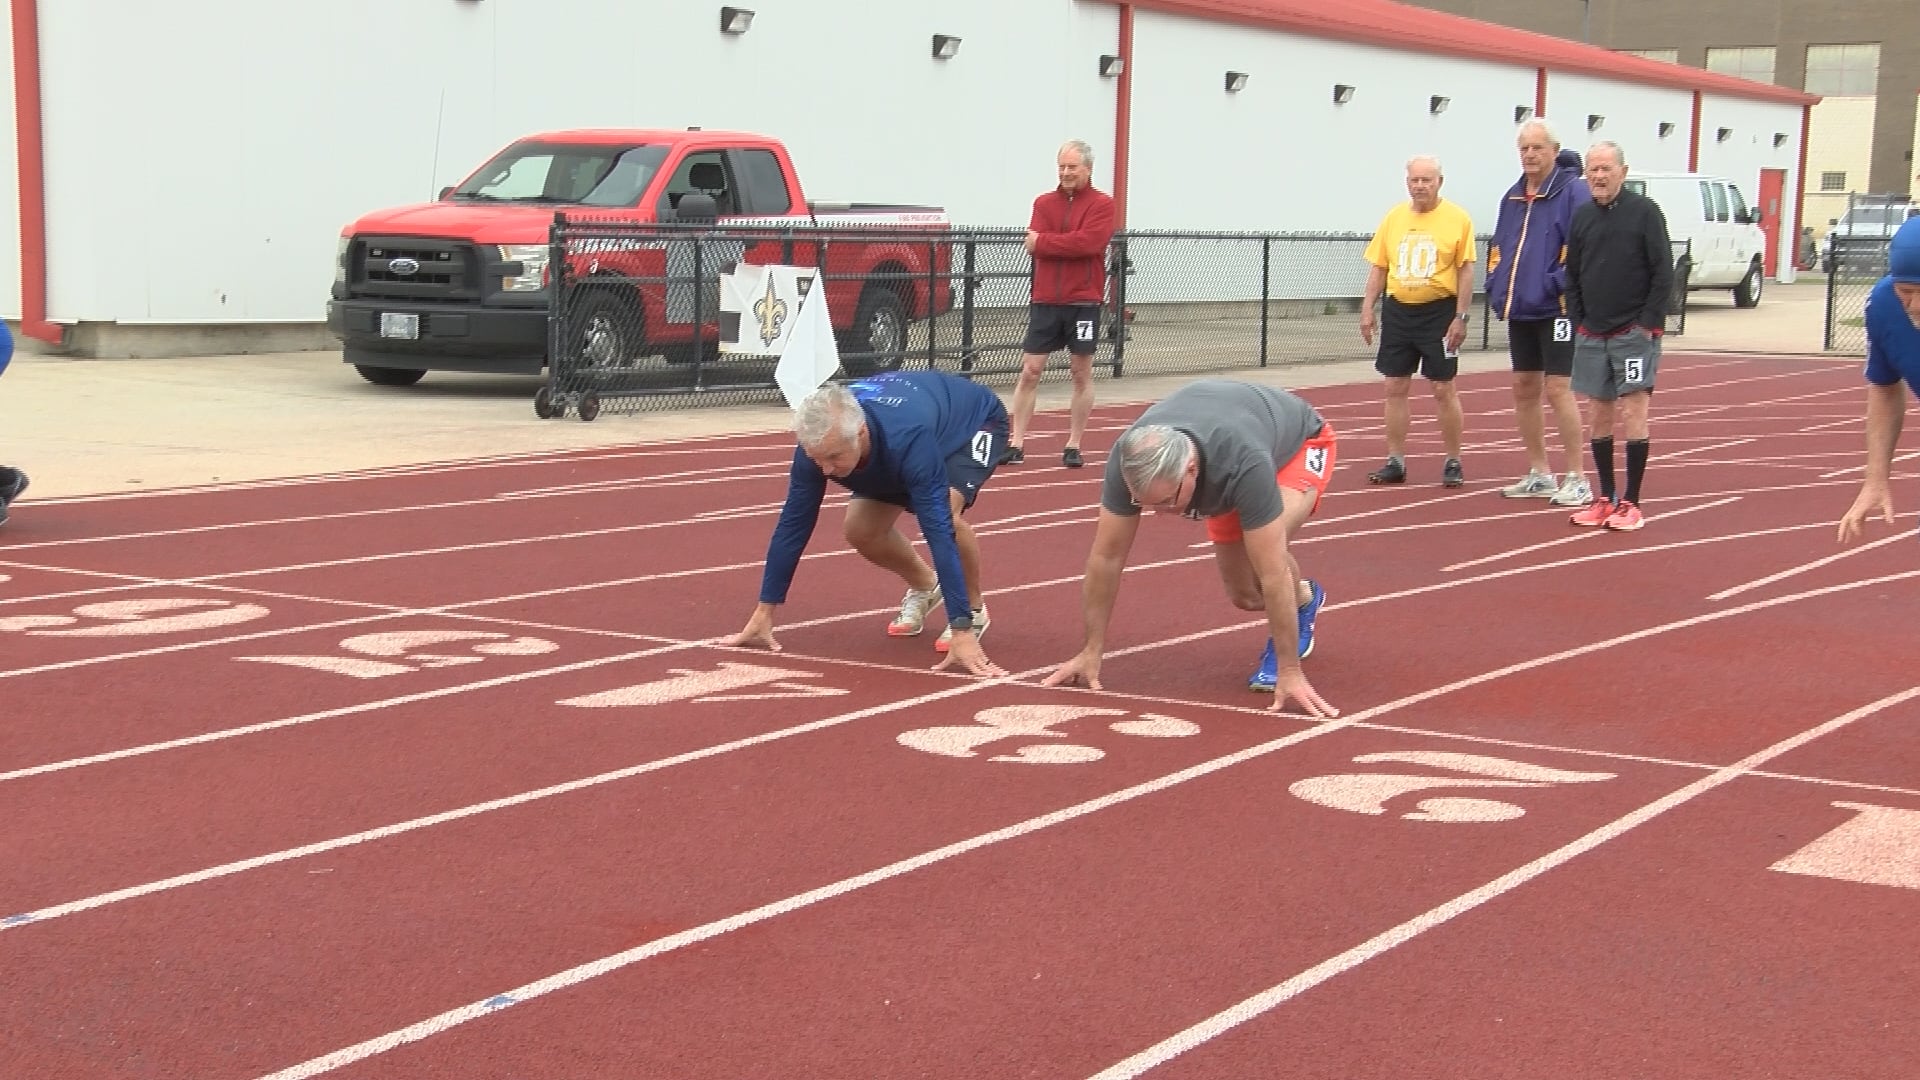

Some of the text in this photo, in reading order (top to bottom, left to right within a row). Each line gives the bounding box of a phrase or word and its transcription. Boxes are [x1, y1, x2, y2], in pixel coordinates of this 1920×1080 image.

[1397, 242, 1437, 279] 10
[1078, 322, 1091, 338] 7
[1556, 320, 1568, 340] 3
[1627, 360, 1641, 380] 5
[975, 434, 990, 463] 4
[1308, 447, 1324, 473] 3
[233, 631, 560, 679] 5
[555, 662, 851, 708] 4
[896, 704, 1201, 764] 3
[1288, 750, 1618, 824] 2
